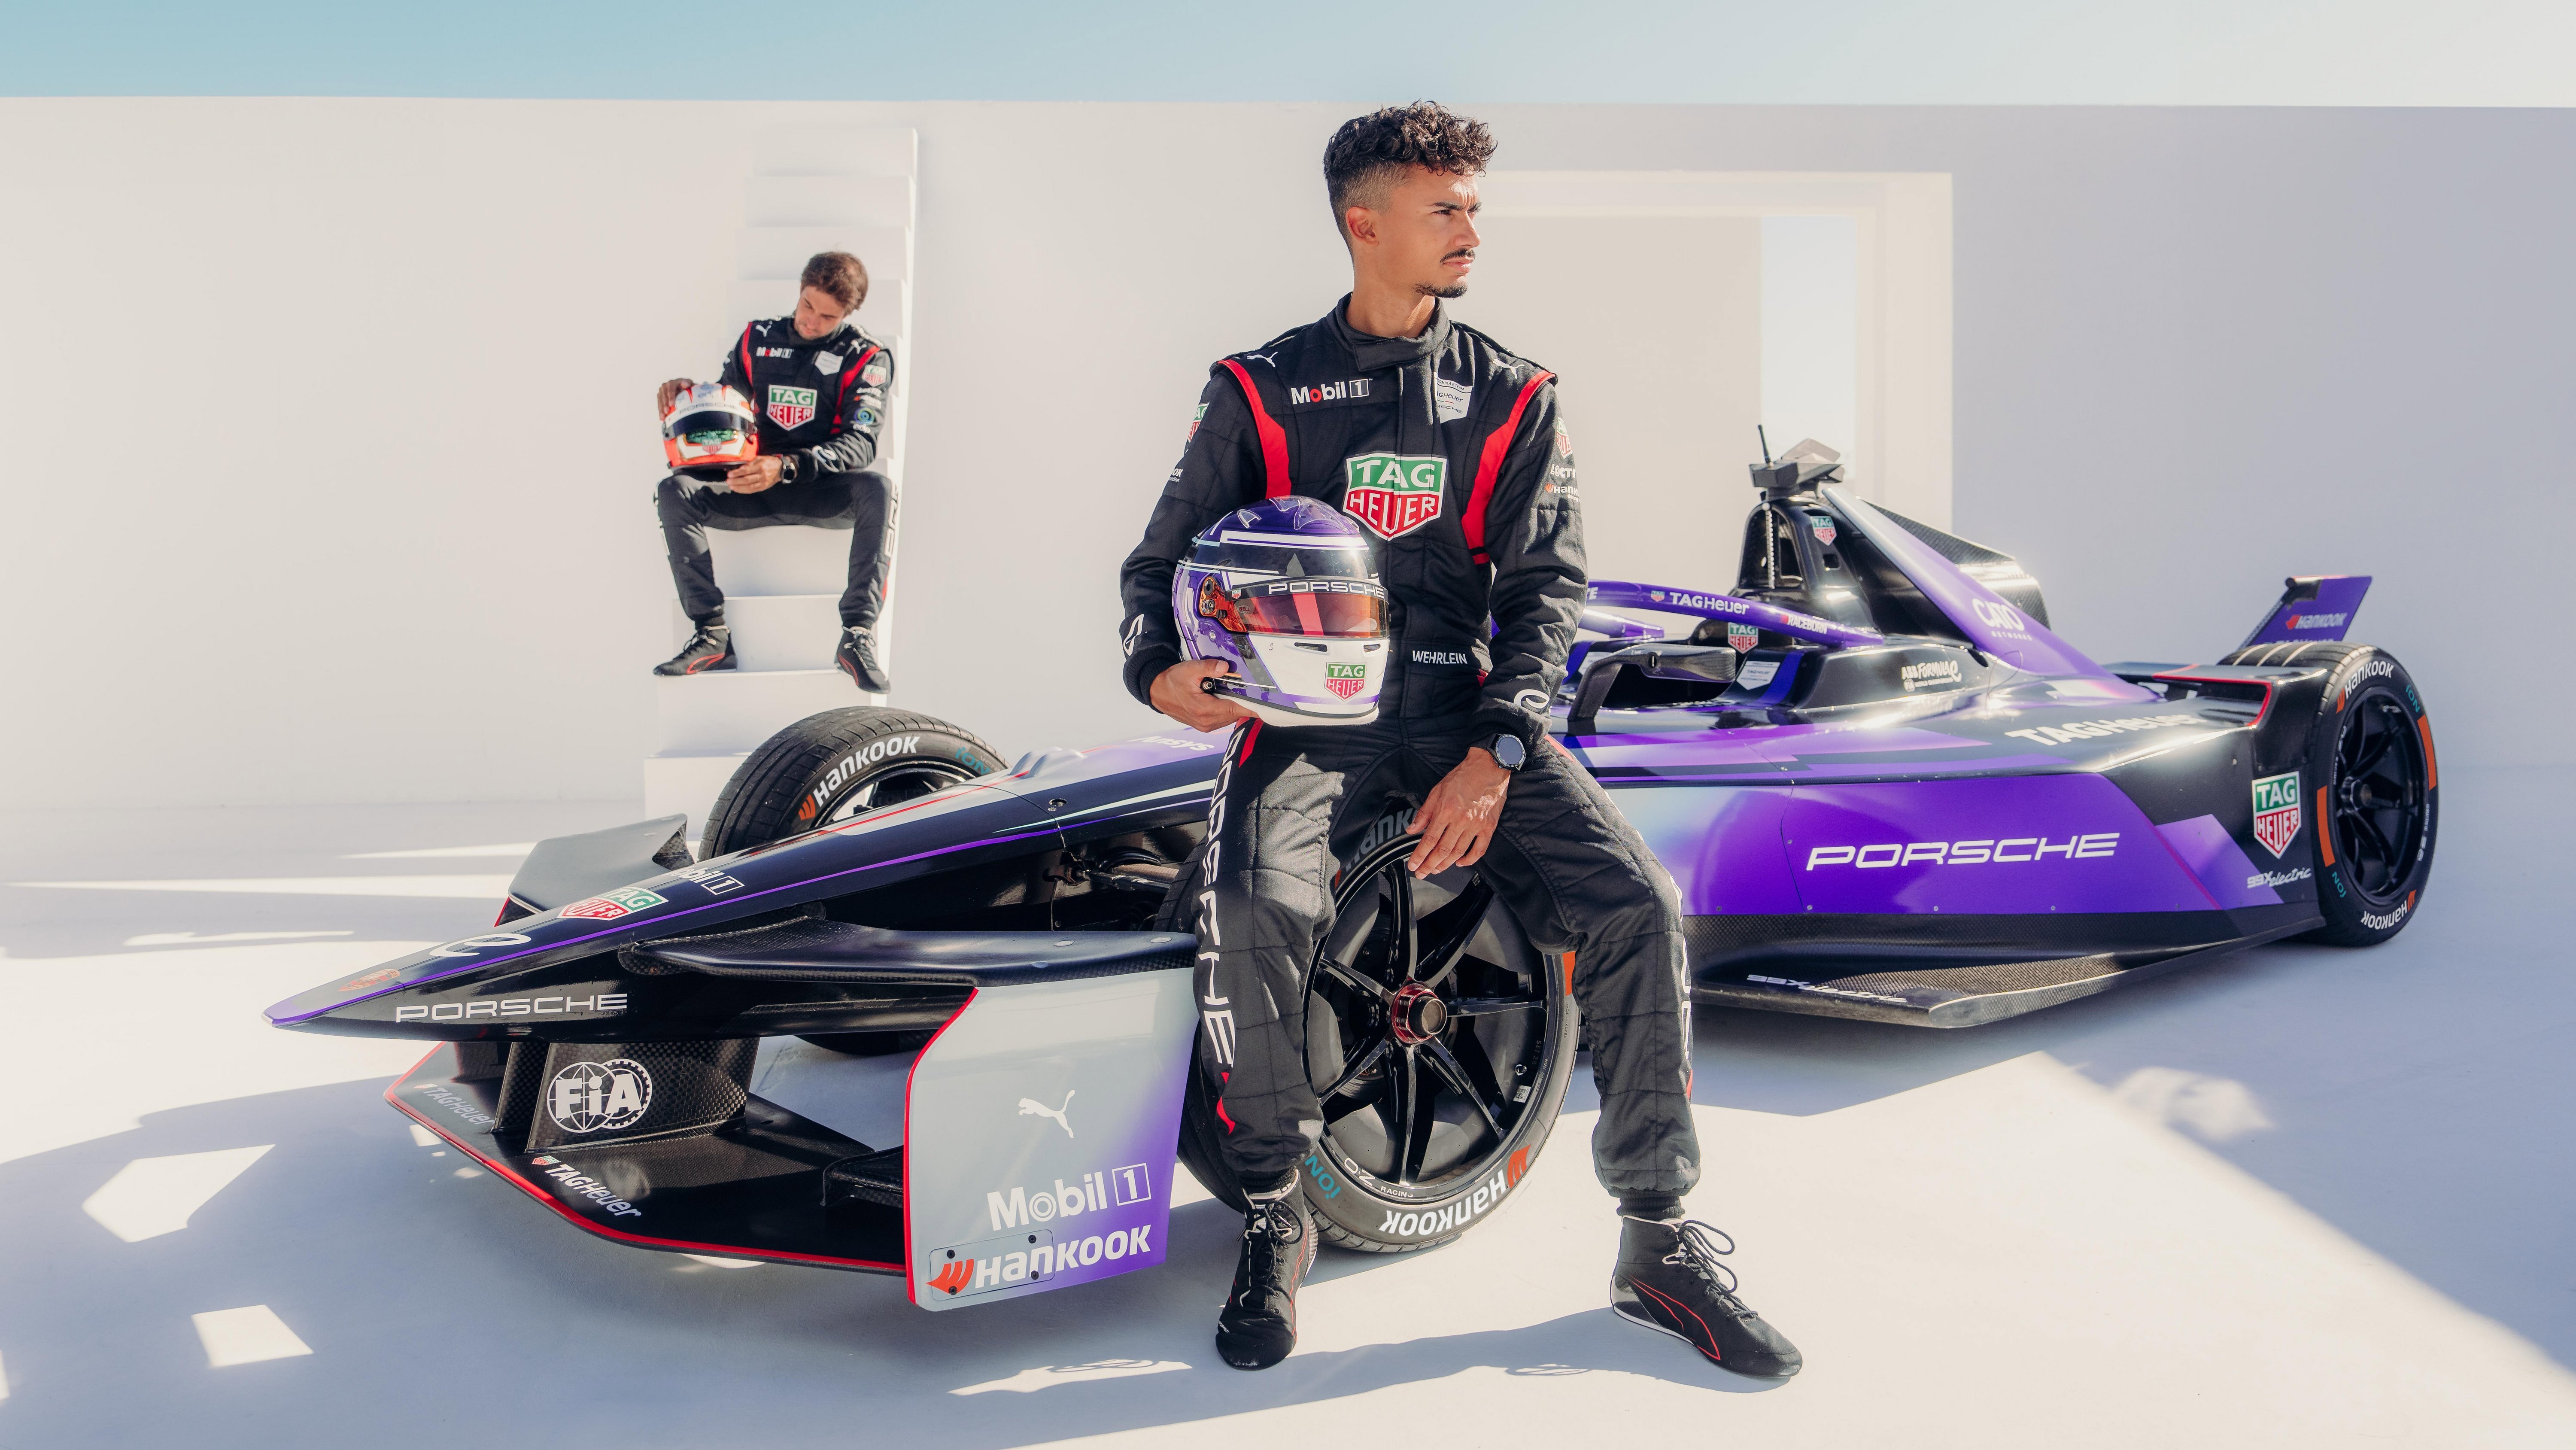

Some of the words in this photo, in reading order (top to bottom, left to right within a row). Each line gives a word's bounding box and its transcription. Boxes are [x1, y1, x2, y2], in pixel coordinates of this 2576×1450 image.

[756, 347, 781, 357] Mobil
[772, 389, 811, 405] TAG
[1291, 381, 1346, 404] Mobil
[1437, 390, 1464, 402] GHeuer
[770, 404, 811, 428] HEUER
[1437, 404, 1463, 413] RSCHE
[1356, 459, 1435, 488] TAG
[1550, 464, 1575, 478] LOCTI
[1349, 492, 1435, 538] HEUER
[1814, 518, 1832, 527] TAG
[1269, 581, 1385, 599] PORSCHE
[1787, 615, 1828, 634] RACEBORN
[1972, 598, 2025, 631] CATO
[1731, 624, 1756, 634] TAG
[1730, 636, 1756, 651] HEUER
[1413, 650, 1468, 664] WEHRLEIN
[1330, 664, 1364, 677] TAG
[1327, 679, 1364, 699] HEUER
[2256, 779, 2295, 809] TAG
[2257, 809, 2299, 852] HEUER
[1806, 832, 2120, 871] PORSCHE
[2269, 867, 2312, 887] electric
[605, 887, 656, 907] TAG
[565, 898, 620, 918] HEUER
[396, 994, 628, 1023] PORSCHE
[987, 1171, 1108, 1231] Mobil
